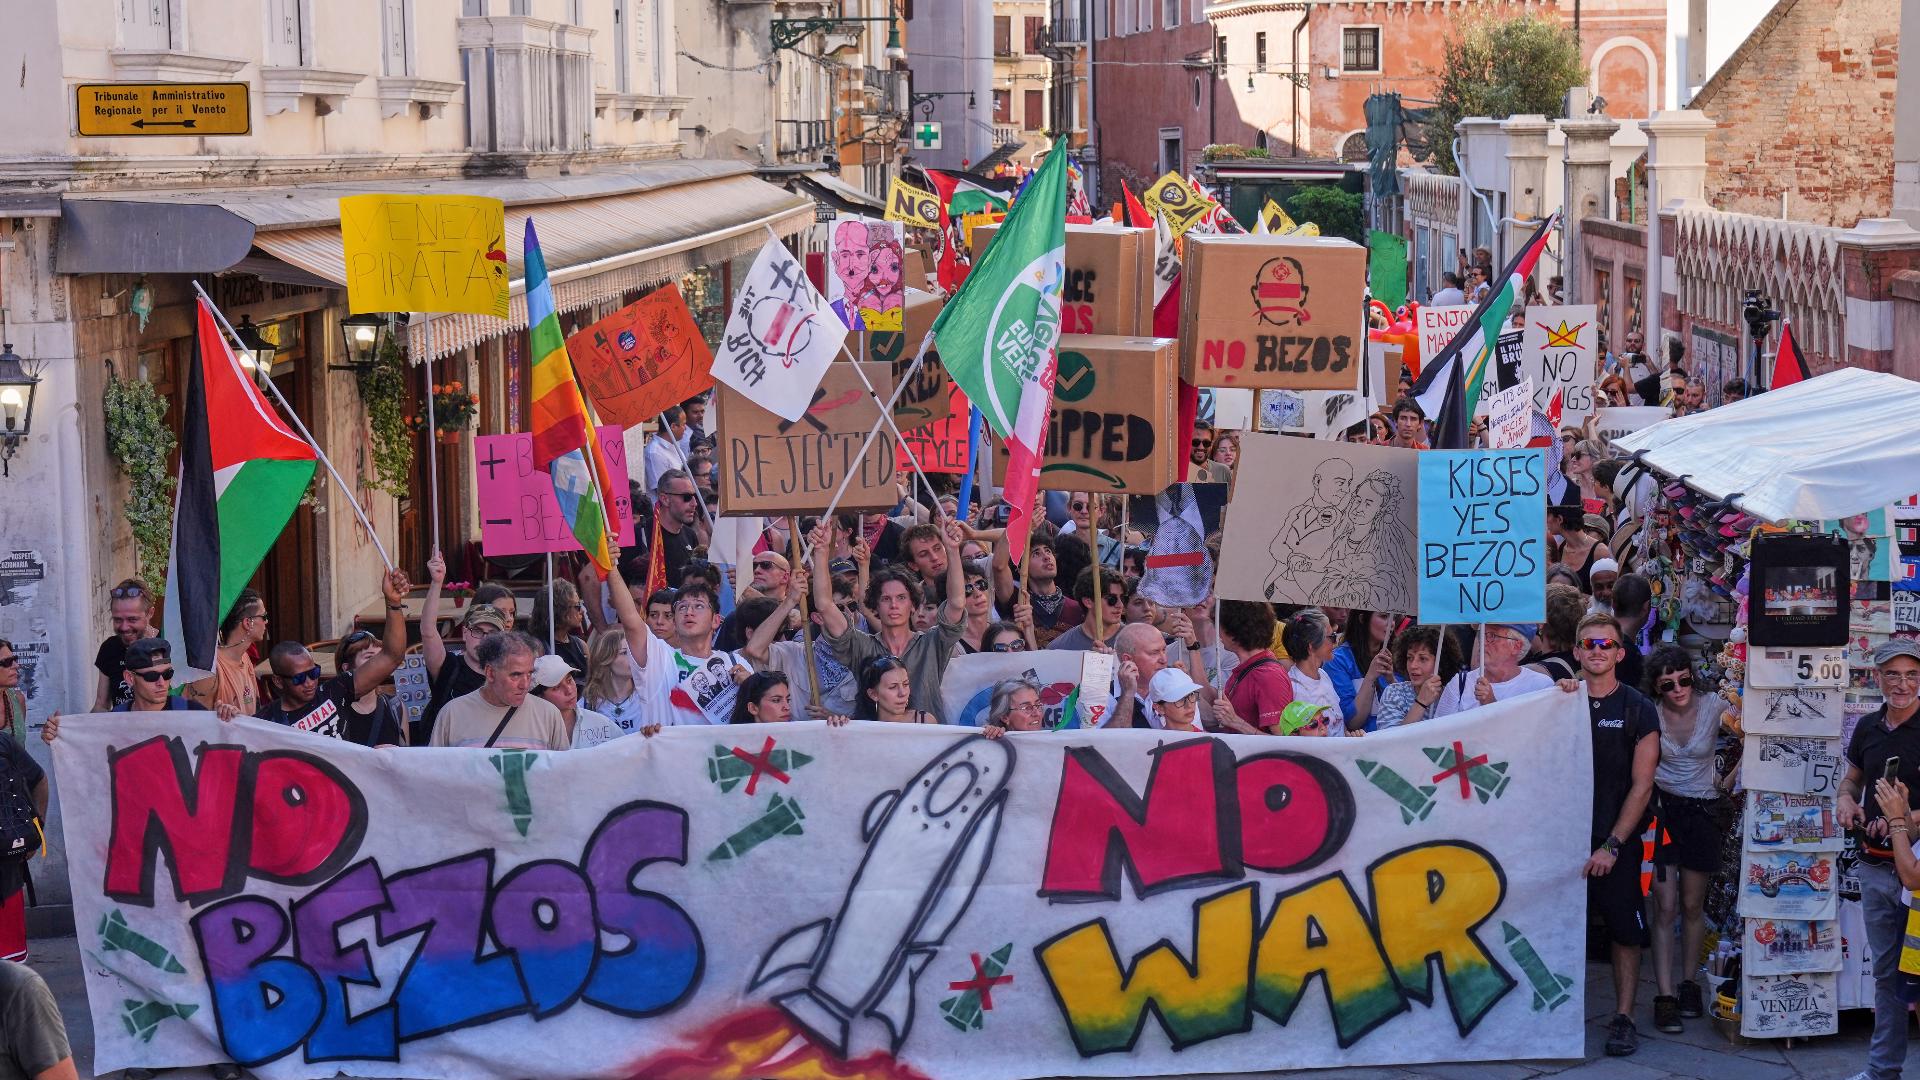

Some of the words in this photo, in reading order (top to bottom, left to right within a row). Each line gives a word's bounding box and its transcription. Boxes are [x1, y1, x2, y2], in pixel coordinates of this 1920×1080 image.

[94, 91, 138, 101] Tribunale
[152, 90, 225, 101] Amministrativo
[95, 105, 142, 117] Regionale
[152, 106, 168, 117] per
[176, 105, 183, 114] il
[192, 104, 226, 114] Veneto
[895, 188, 940, 223] NO
[353, 249, 495, 299] PIRATA
[1203, 339, 1246, 370] NO
[1254, 335, 1352, 373] BEZOS
[1500, 345, 1507, 354] IL
[1508, 342, 1524, 352] PIA
[1542, 351, 1578, 383] NO
[732, 430, 894, 498] REJECTED
[901, 437, 967, 468] STYLE
[1449, 454, 1540, 499] KISSES
[1452, 500, 1511, 536] YES
[1425, 538, 1537, 578] BEZOS
[1459, 580, 1505, 613] NO
[1797, 654, 1843, 682] 5,00
[297, 702, 335, 731] GINAL
[1782, 792, 1820, 807] VENEZIA
[104, 735, 369, 907] NO
[1036, 736, 1356, 904] NO
[190, 800, 706, 1064] BEZOS
[1034, 840, 1518, 1057] WAR
[1760, 997, 1819, 1013] VENEZIA
